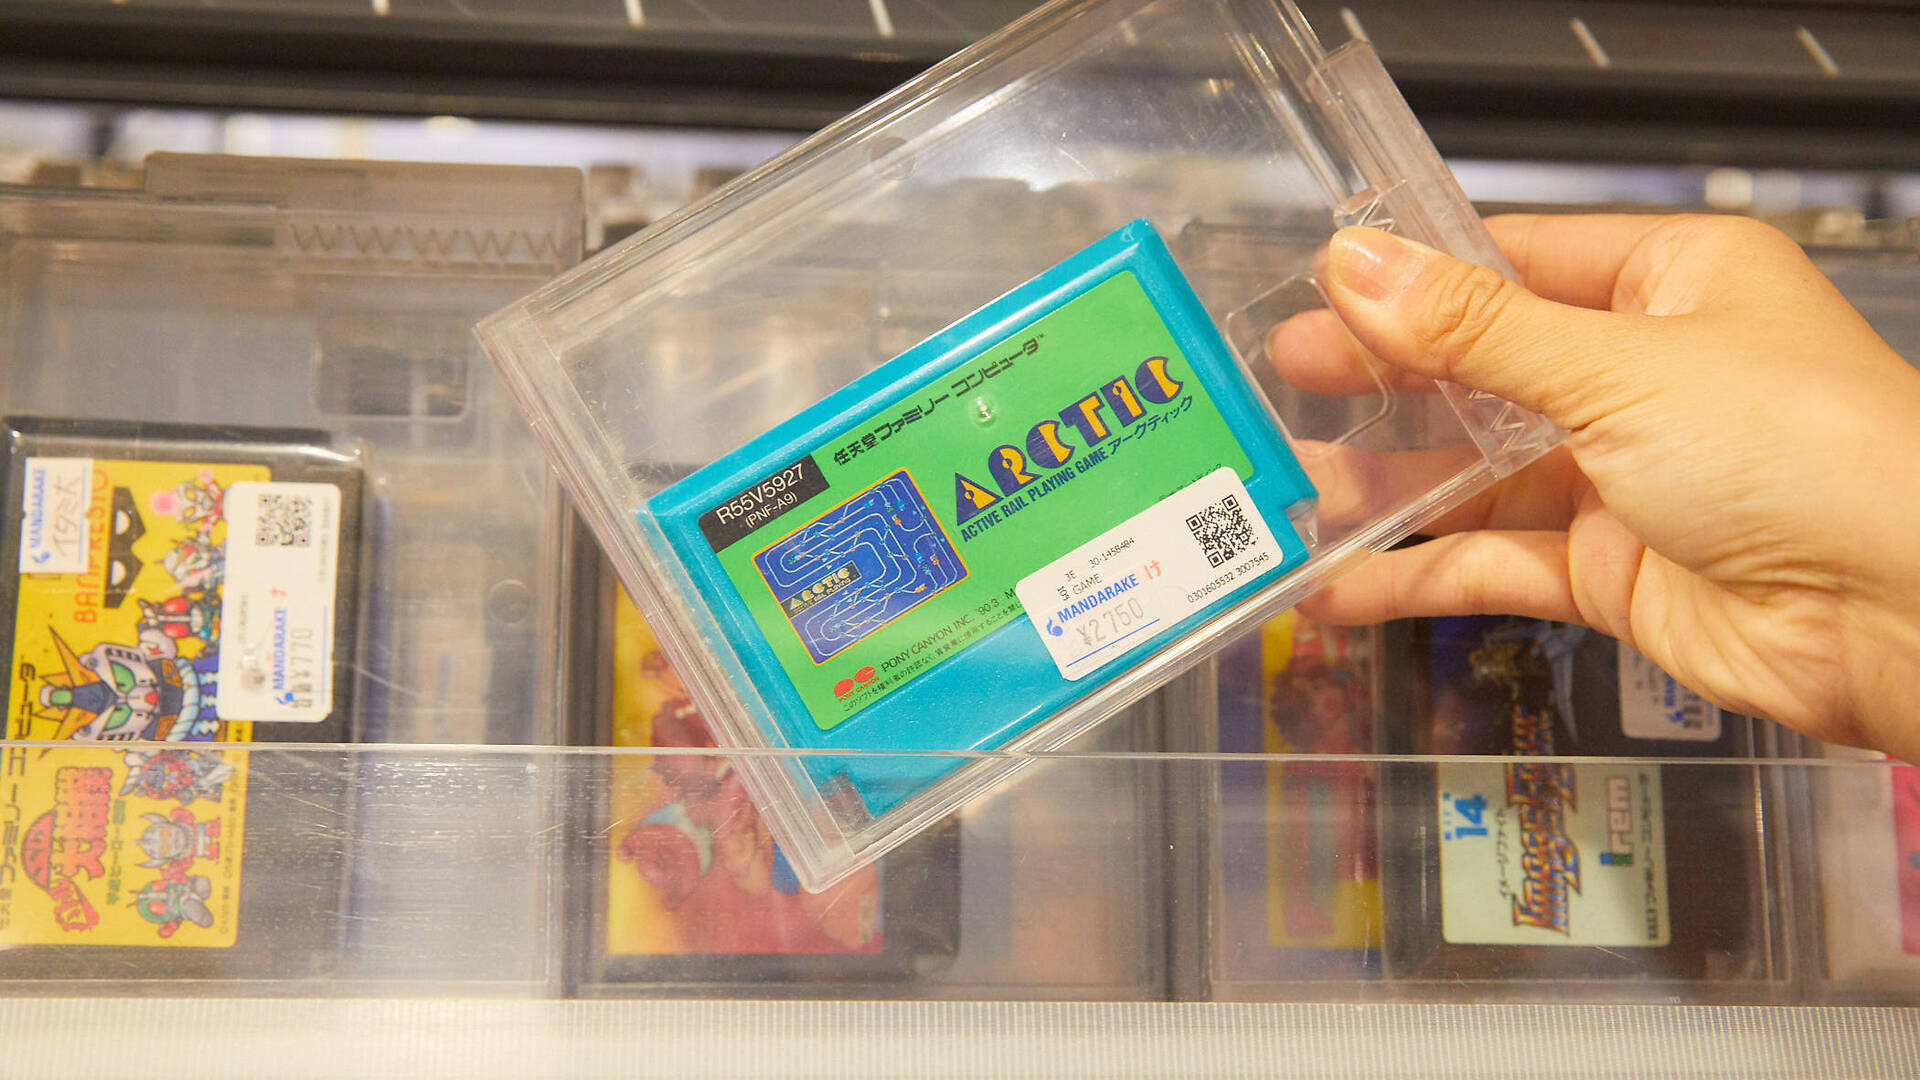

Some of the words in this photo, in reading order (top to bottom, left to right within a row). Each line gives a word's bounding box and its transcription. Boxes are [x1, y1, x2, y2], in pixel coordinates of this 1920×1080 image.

[833, 393, 950, 466] 任天堂ファミリー
[954, 356, 1183, 526] ARCTIC
[715, 463, 806, 526] R55V5927
[960, 509, 1002, 542] ACTIVE
[1001, 494, 1029, 518] RAIL
[1028, 466, 1076, 502] PLAYING
[1075, 446, 1109, 474] GAME
[1109, 394, 1193, 455] アークティック
[745, 491, 798, 529] (PNF-A9)
[1056, 573, 1140, 624] MANDARAKE
[1143, 559, 1163, 580] け
[1064, 570, 1077, 582] 3E
[1073, 573, 1103, 596] GAME
[1187, 571, 1236, 604] 0301605532
[272, 608, 288, 691] MANDARAKE
[881, 649, 911, 672] PONY
[911, 627, 953, 656] CANYON
[1075, 596, 1145, 647] ¥2750
[1454, 793, 1488, 839] 14
[1600, 777, 1634, 866] irem
